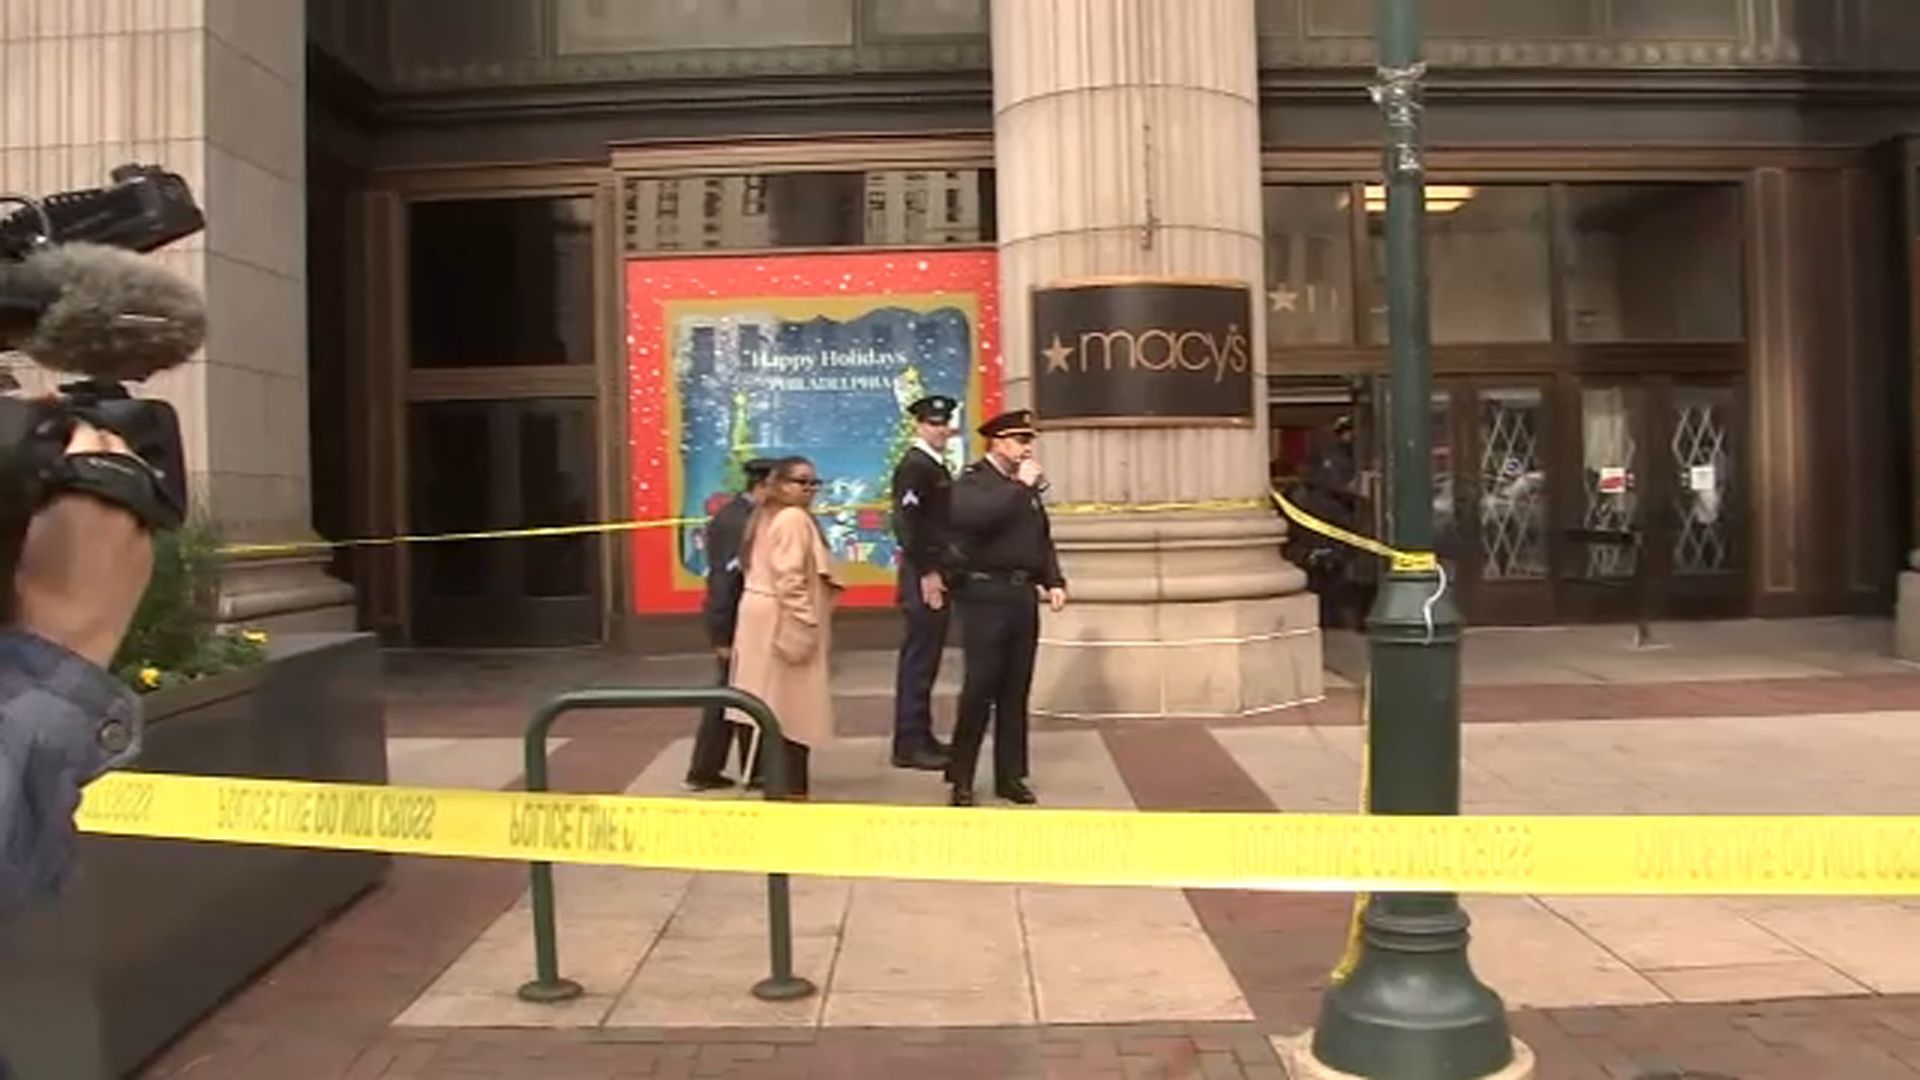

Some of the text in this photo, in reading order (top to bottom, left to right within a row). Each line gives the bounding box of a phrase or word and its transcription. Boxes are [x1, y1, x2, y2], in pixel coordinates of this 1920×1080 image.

[751, 347, 908, 371] Happy Holidays
[1080, 324, 1247, 384] macy's
